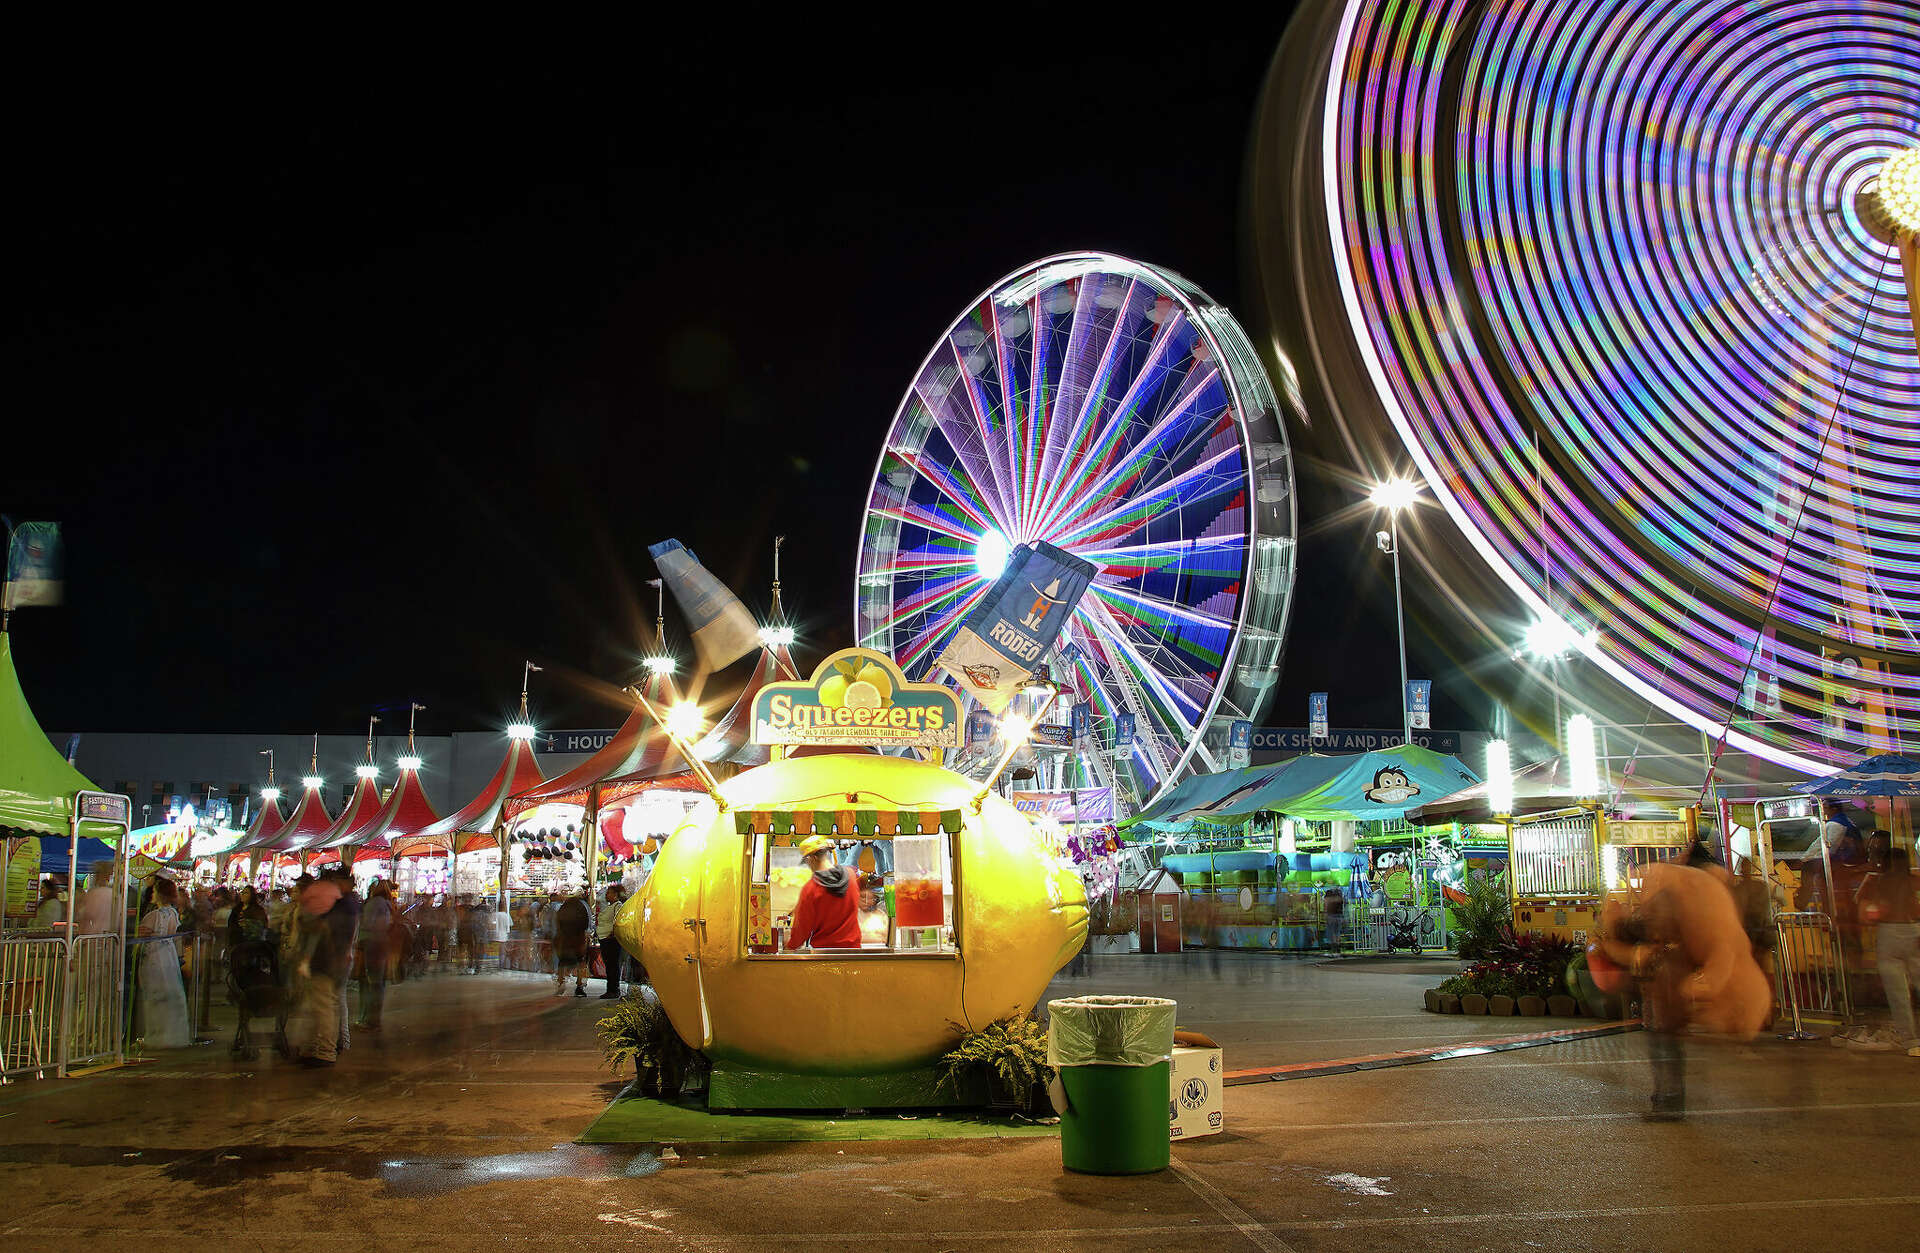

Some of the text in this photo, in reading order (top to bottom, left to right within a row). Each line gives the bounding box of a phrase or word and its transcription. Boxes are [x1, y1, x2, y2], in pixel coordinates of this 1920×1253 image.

[989, 621, 1041, 662] RODEO
[769, 693, 944, 730] Squeezers
[846, 728, 879, 736] LEMONADE
[568, 735, 613, 750] HOUS
[1291, 734, 1340, 748] SHOW
[1344, 735, 1377, 748] AND
[1610, 824, 1681, 840] ENTER
